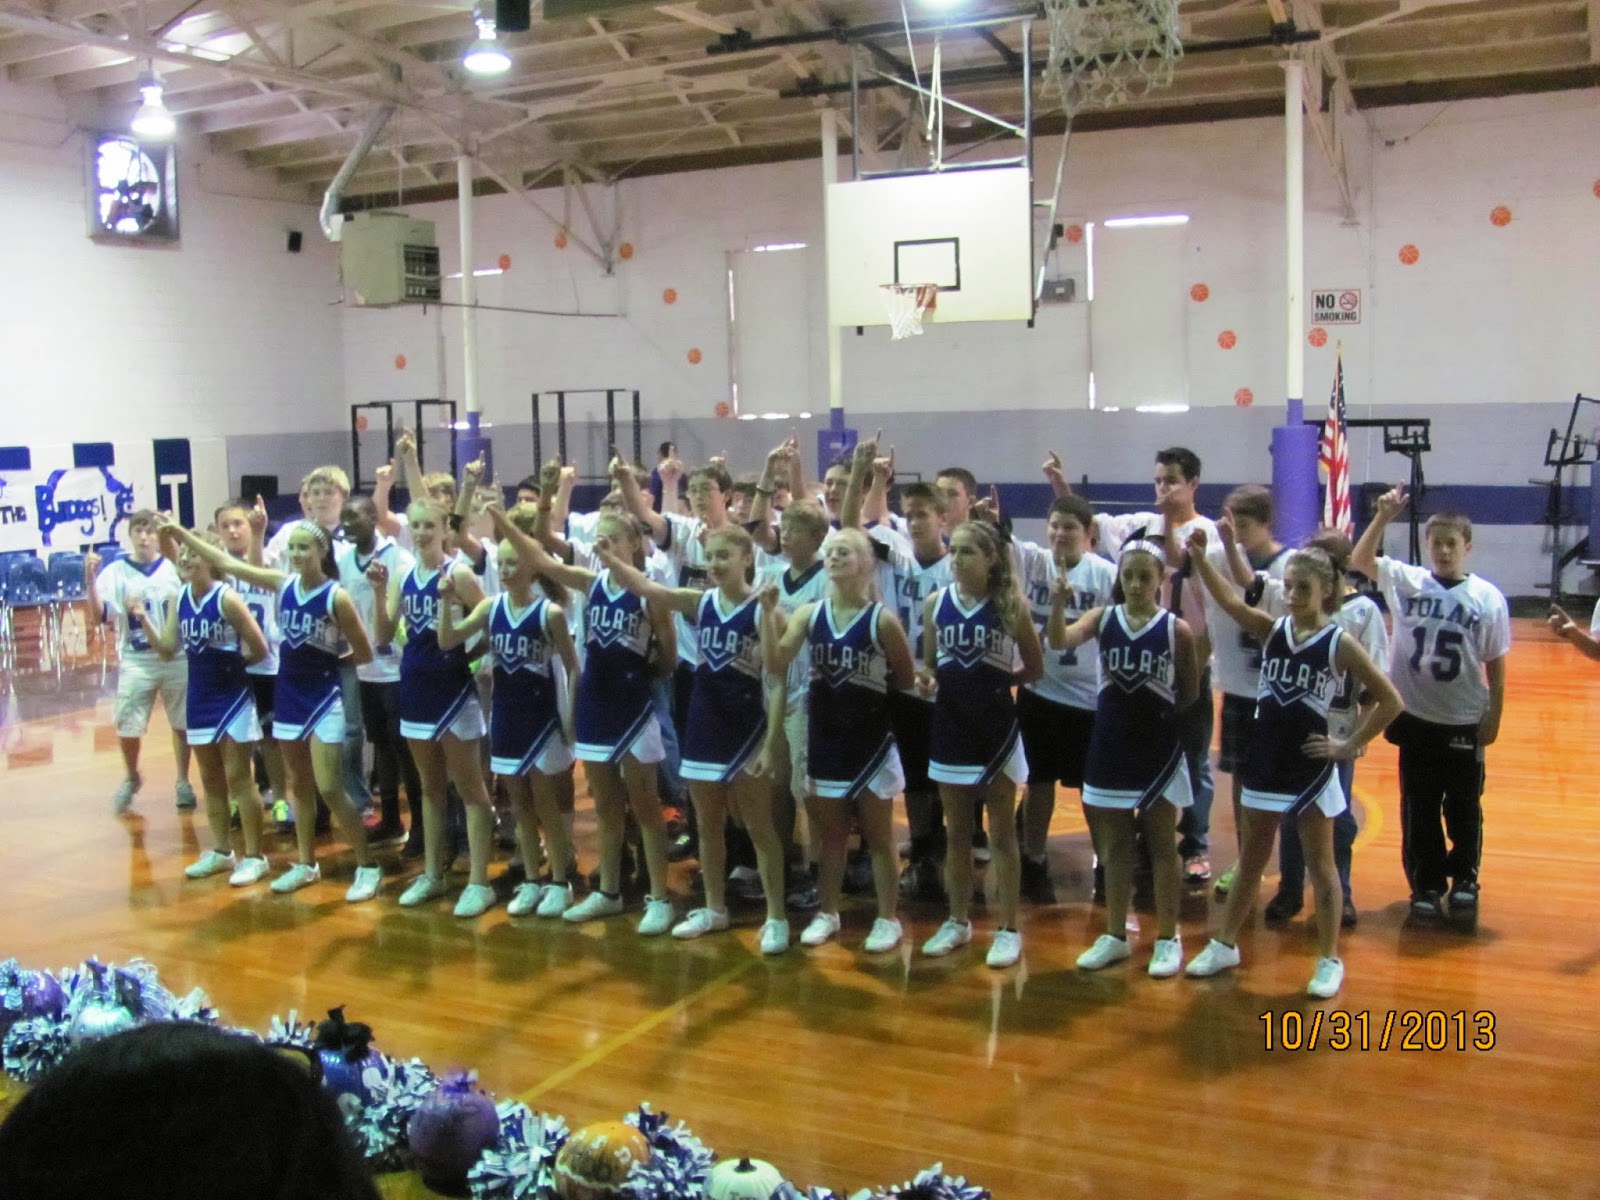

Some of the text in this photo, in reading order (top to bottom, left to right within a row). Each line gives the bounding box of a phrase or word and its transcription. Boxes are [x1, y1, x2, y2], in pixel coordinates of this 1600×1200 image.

[1314, 311, 1357, 322] SMOKING
[1316, 294, 1335, 309] NO
[181, 617, 223, 641] OLAR
[281, 609, 326, 639] OLAR
[590, 605, 640, 637] OLAR
[701, 626, 753, 660] OLAR
[1410, 626, 1464, 682] 15
[810, 643, 869, 678] OLAR
[1103, 646, 1169, 684] OLAR
